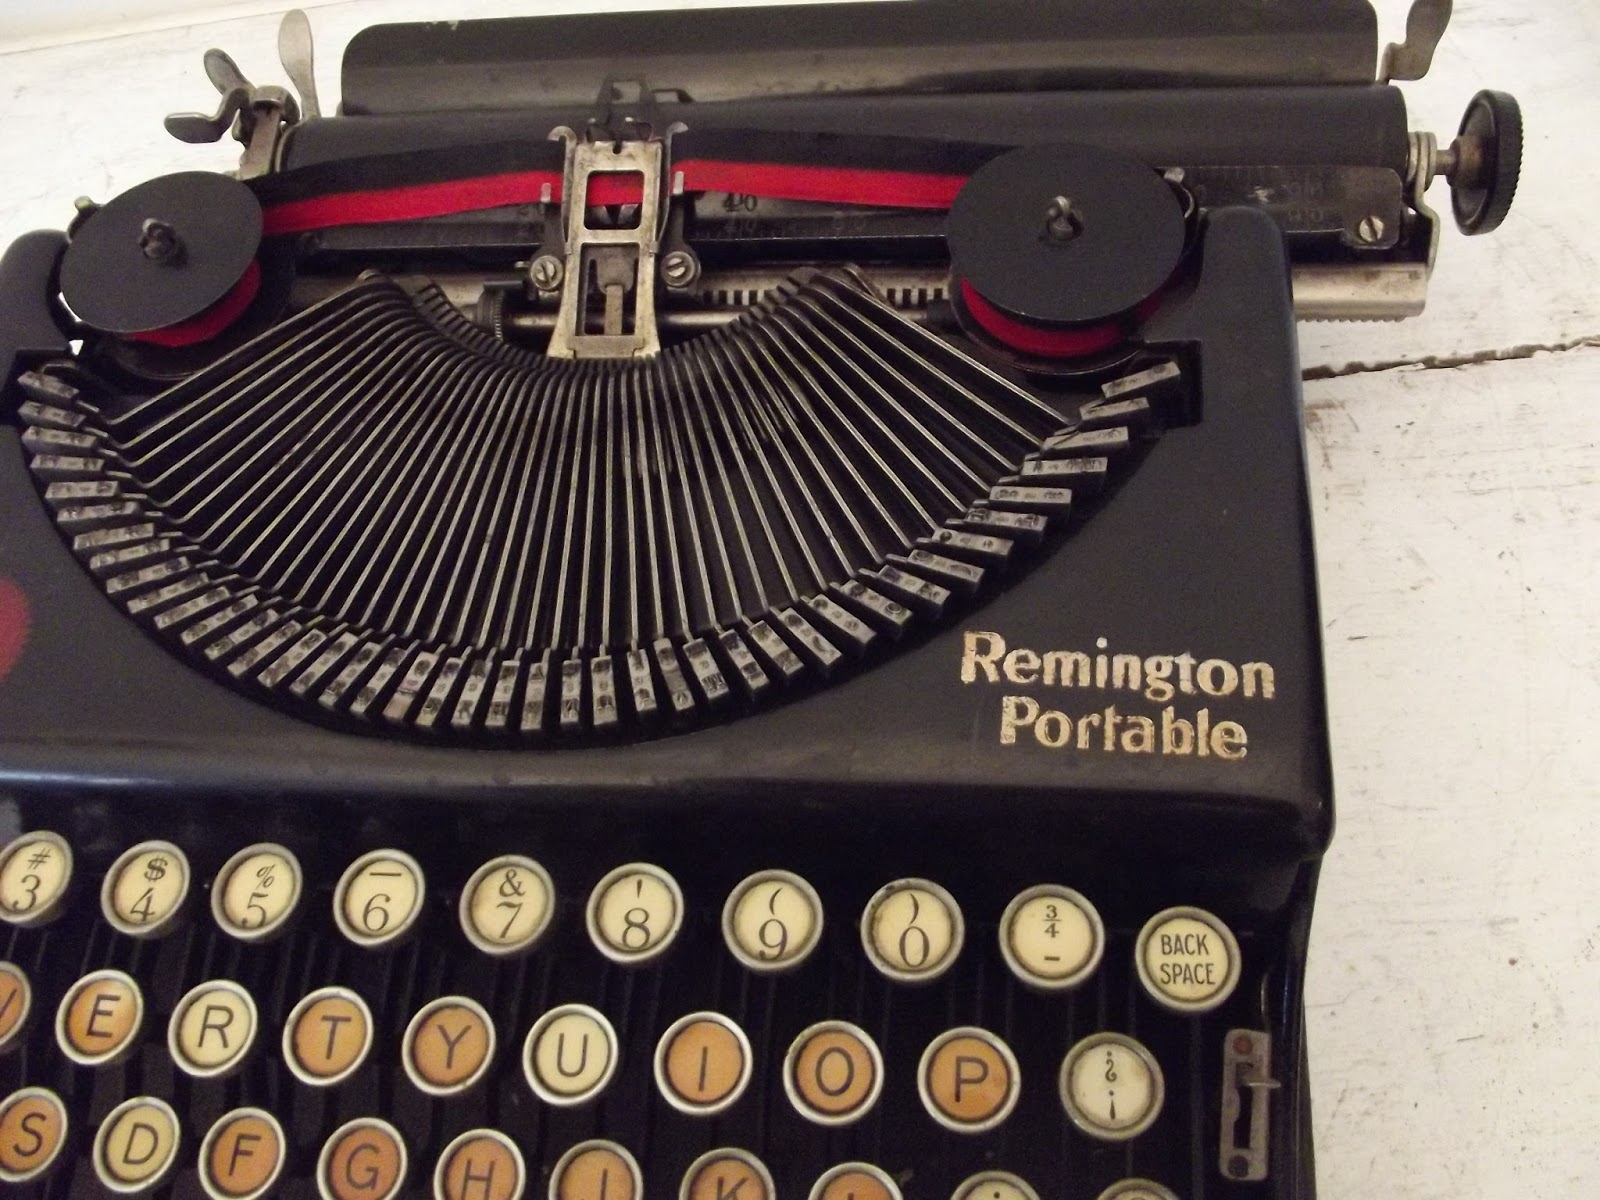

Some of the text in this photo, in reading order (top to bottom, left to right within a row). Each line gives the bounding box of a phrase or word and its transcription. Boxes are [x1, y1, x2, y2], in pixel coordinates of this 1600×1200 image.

[961, 631, 1275, 702] Remington
[1000, 695, 1248, 759] Portable
[144, 856, 168, 882] $
[256, 864, 275, 889] %
[499, 869, 525, 897] &
[12, 875, 41, 911] 3
[130, 888, 155, 922] 4
[241, 892, 269, 928] 5
[362, 893, 390, 931] 6
[496, 901, 523, 938] 7
[622, 907, 650, 948] 8
[758, 919, 788, 960] 9
[1160, 933, 1209, 956] BACK
[1160, 963, 1215, 985] SPACE
[86, 993, 121, 1038] E
[198, 1005, 234, 1048] R
[321, 1016, 351, 1060] T
[437, 1024, 472, 1069] Y
[556, 1033, 589, 1077] U
[699, 1046, 708, 1092] I
[815, 1047, 854, 1096] O
[955, 1056, 989, 1103] P
[12, 1112, 47, 1157] S
[122, 1122, 159, 1165] D
[228, 1133, 262, 1176] F
[345, 1143, 379, 1190] G
[461, 1159, 496, 1200] H
